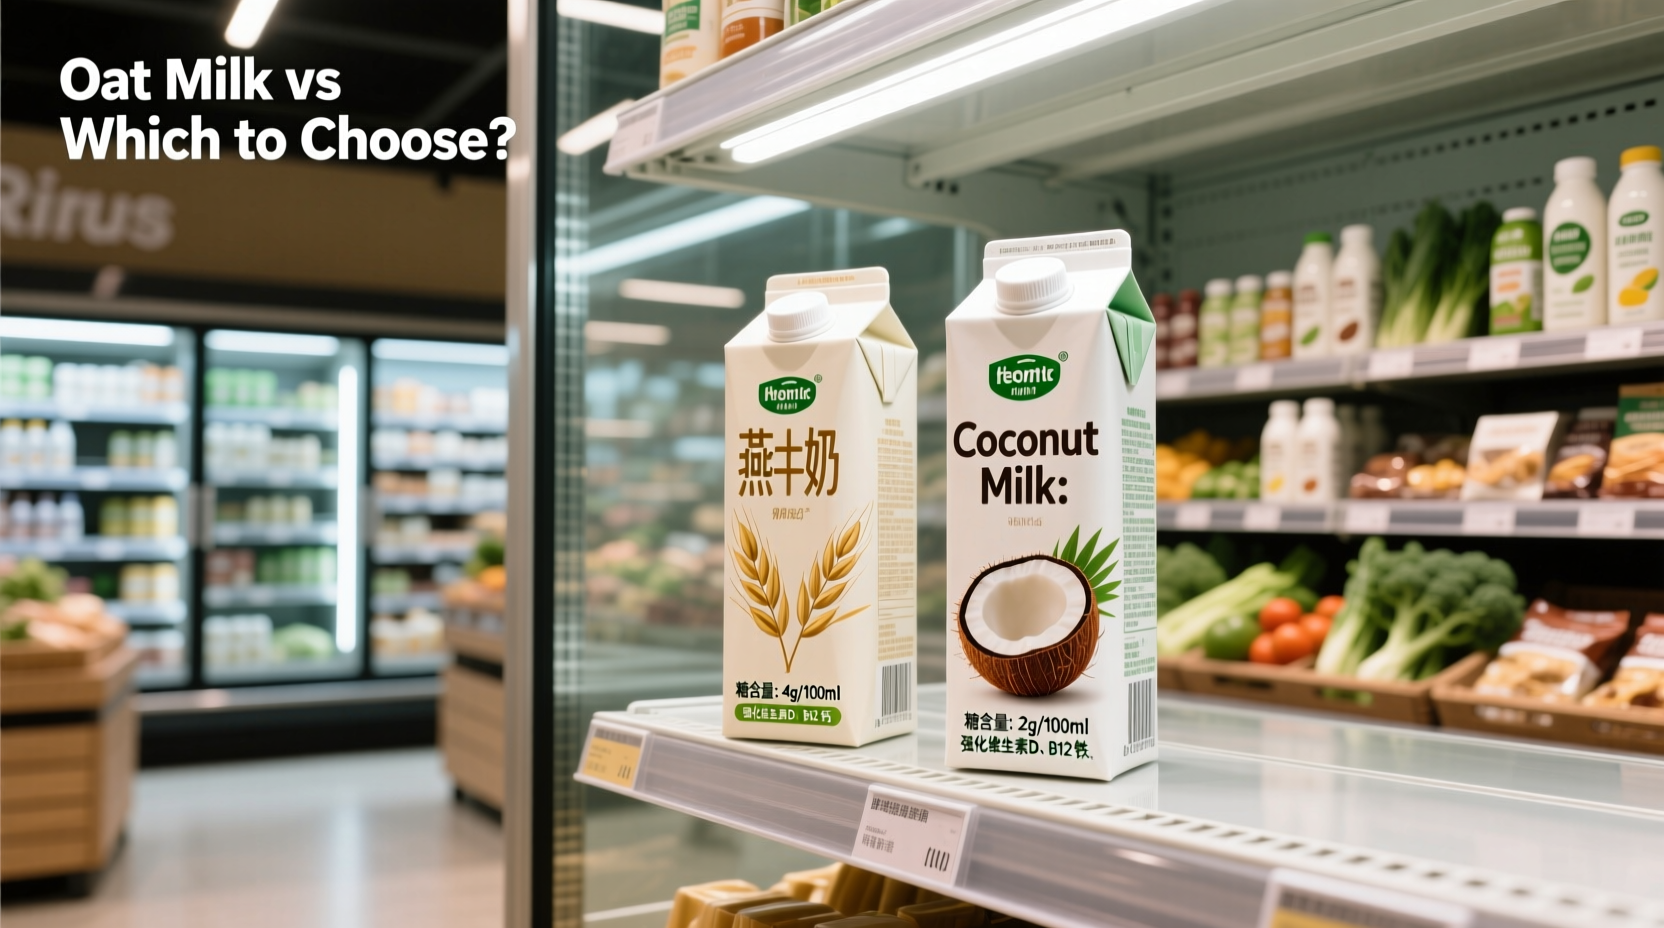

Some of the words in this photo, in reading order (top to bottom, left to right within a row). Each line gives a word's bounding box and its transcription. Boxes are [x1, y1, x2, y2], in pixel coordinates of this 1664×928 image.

[953, 420, 1099, 458] Coconut
[981, 465, 1068, 505] Milk:
[781, 684, 841, 703] 4g/100ml
[1017, 715, 1089, 737] 2g/100ml
